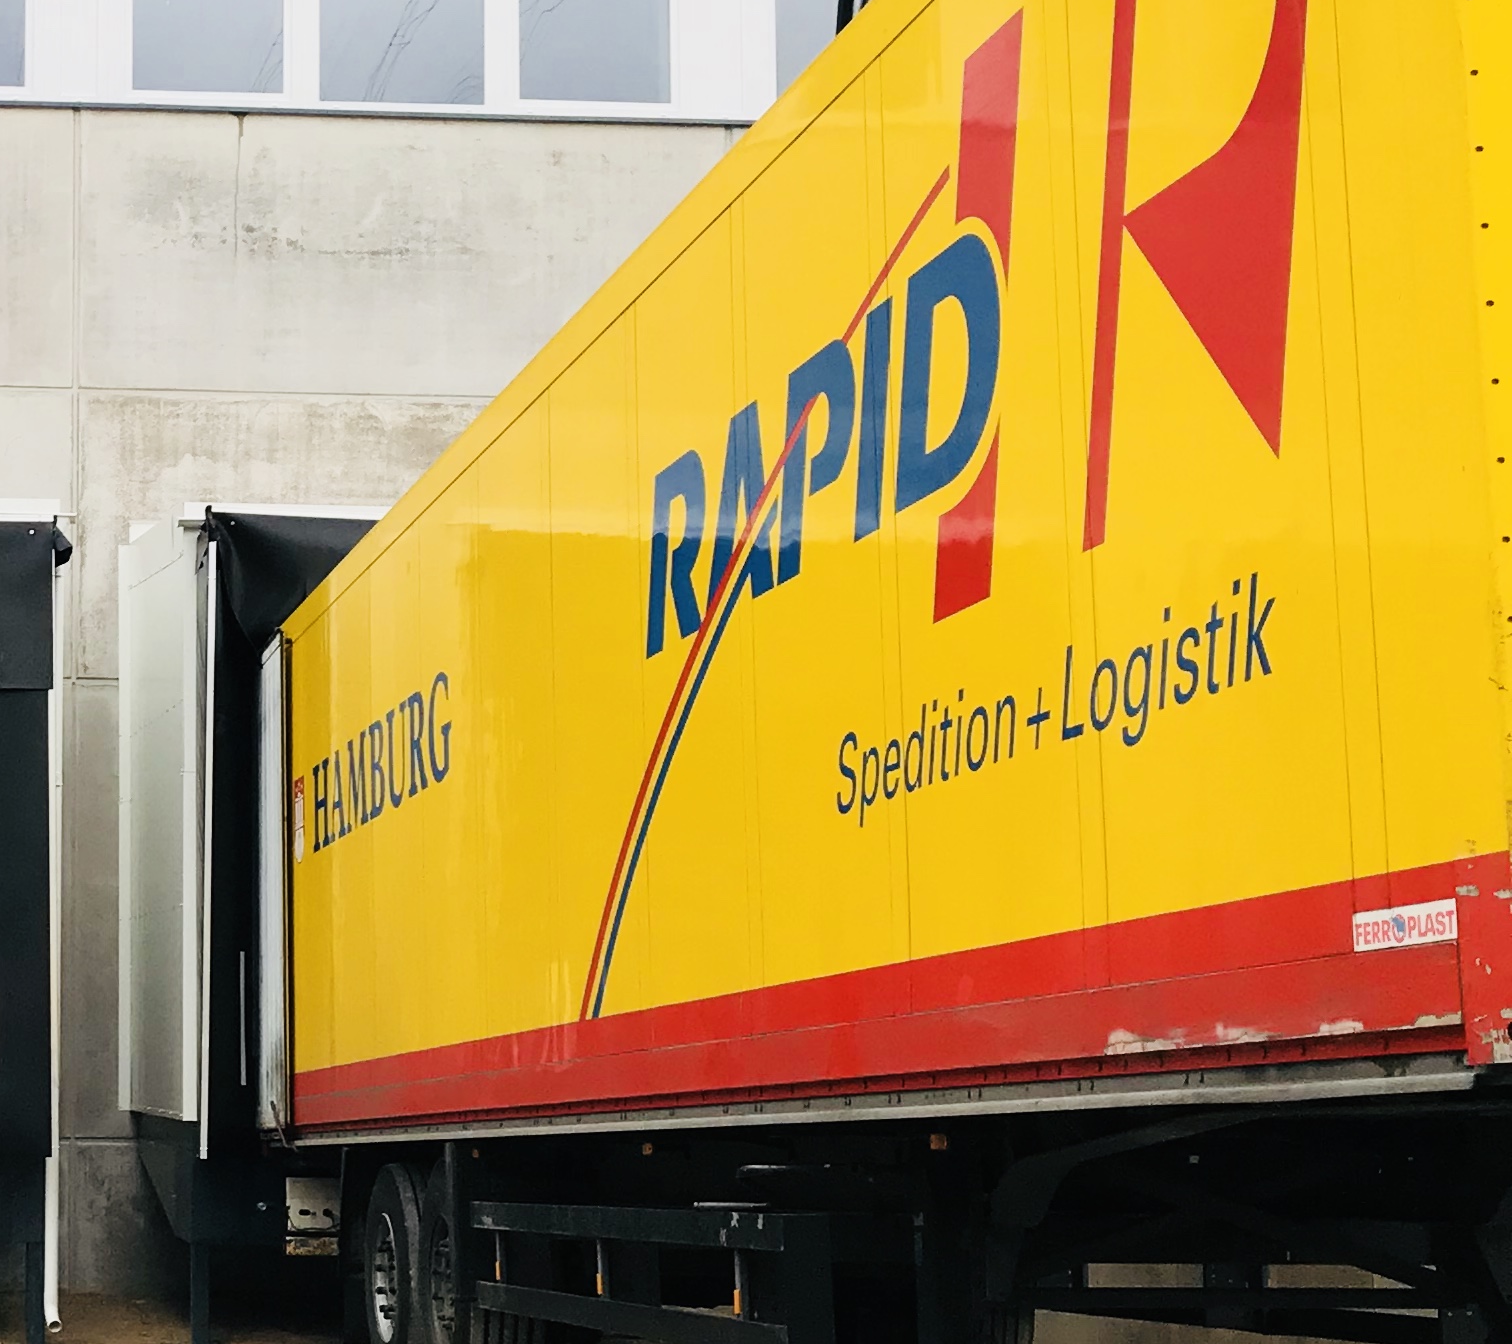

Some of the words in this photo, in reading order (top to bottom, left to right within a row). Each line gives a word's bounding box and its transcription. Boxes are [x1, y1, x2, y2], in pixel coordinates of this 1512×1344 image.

[646, 233, 1001, 659] RAPID
[312, 671, 453, 854] HAMBURG
[1355, 910, 1455, 946] FERROPLAST
